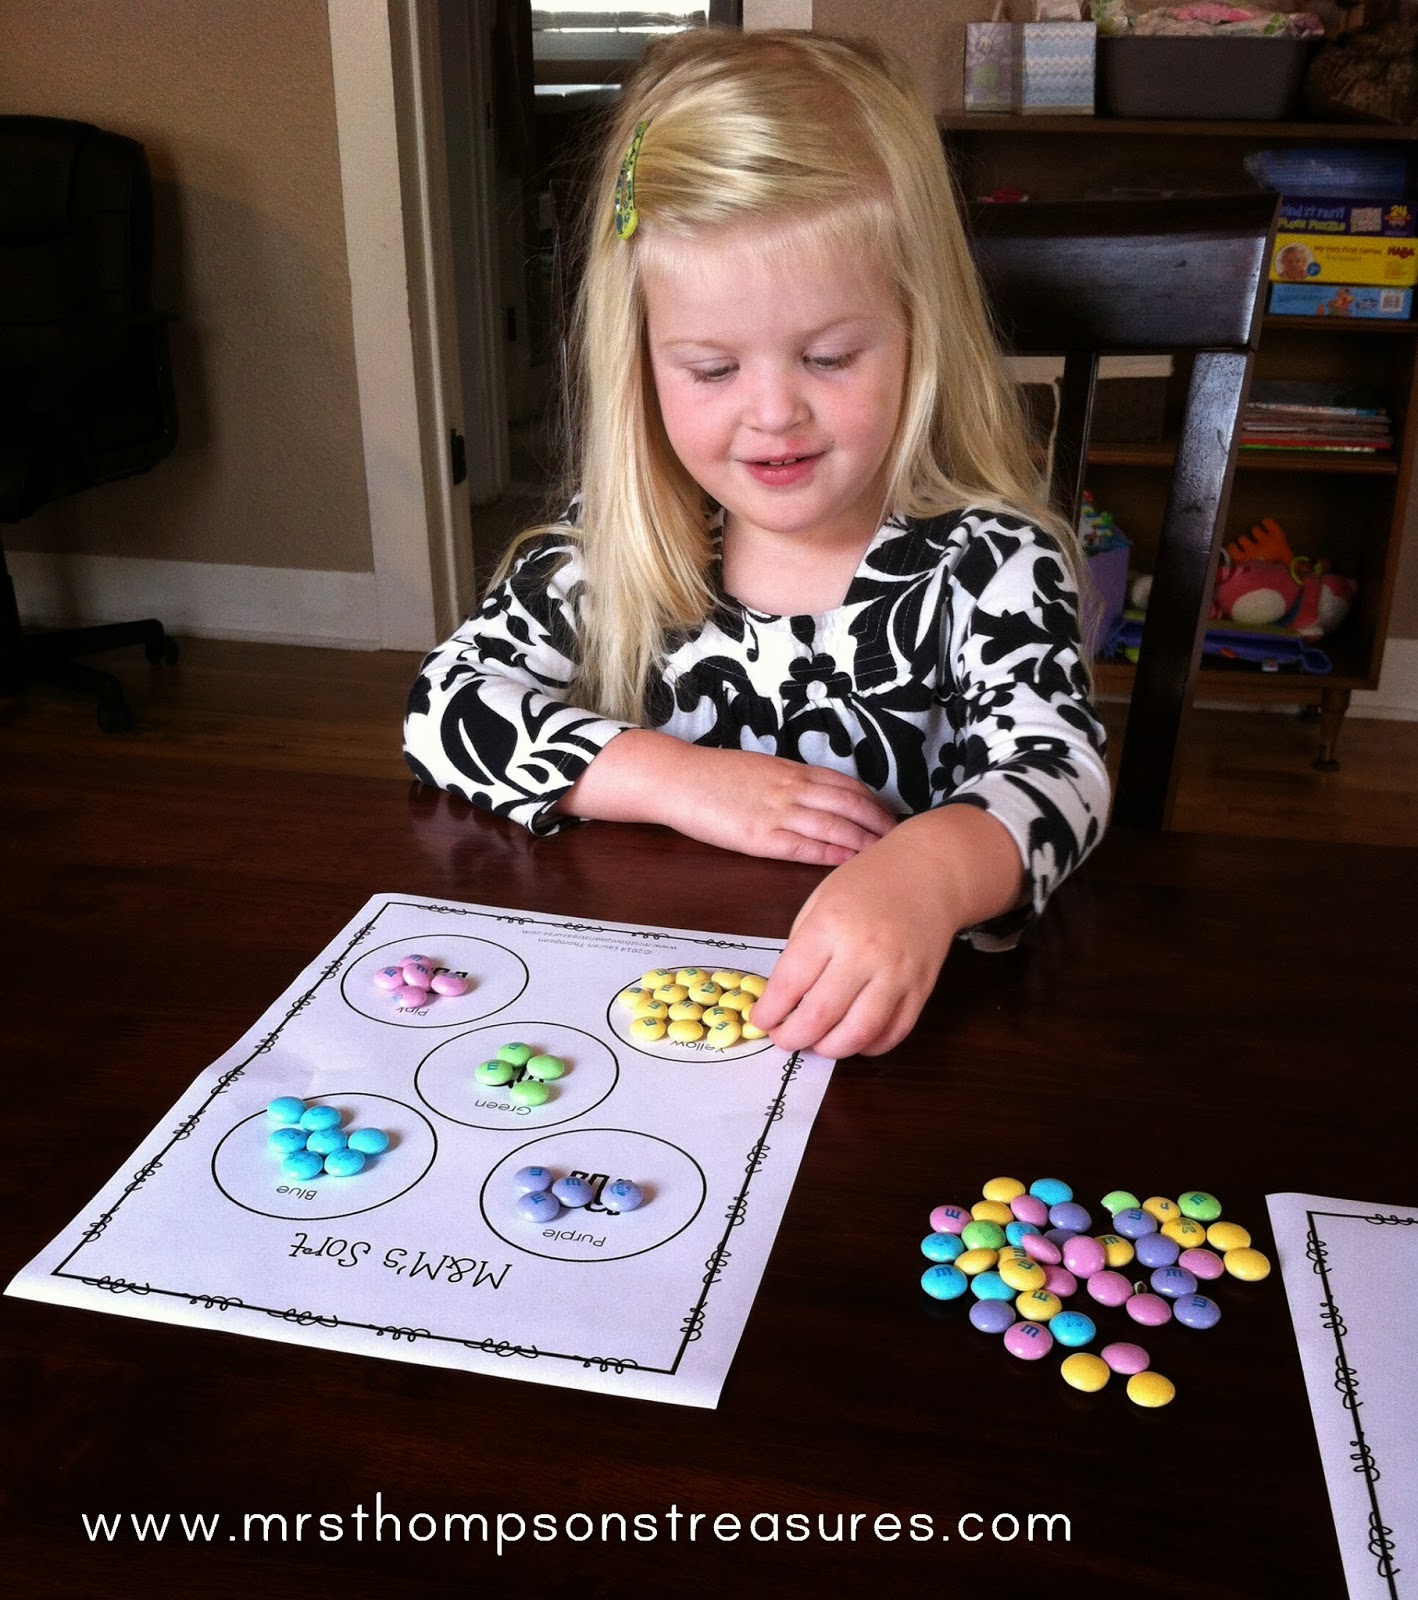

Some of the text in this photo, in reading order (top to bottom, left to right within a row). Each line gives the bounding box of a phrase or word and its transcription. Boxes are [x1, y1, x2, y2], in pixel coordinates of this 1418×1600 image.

[1390, 204, 1408, 217] 24
[1388, 245, 1415, 258] HABA
[538, 938, 585, 948] Thompson
[587, 943, 618, 952] Lauren
[474, 1100, 532, 1115] Green
[276, 1185, 317, 1201] Blue
[542, 1228, 607, 1247] Purple
[288, 1232, 513, 1289] M&M's Sort
